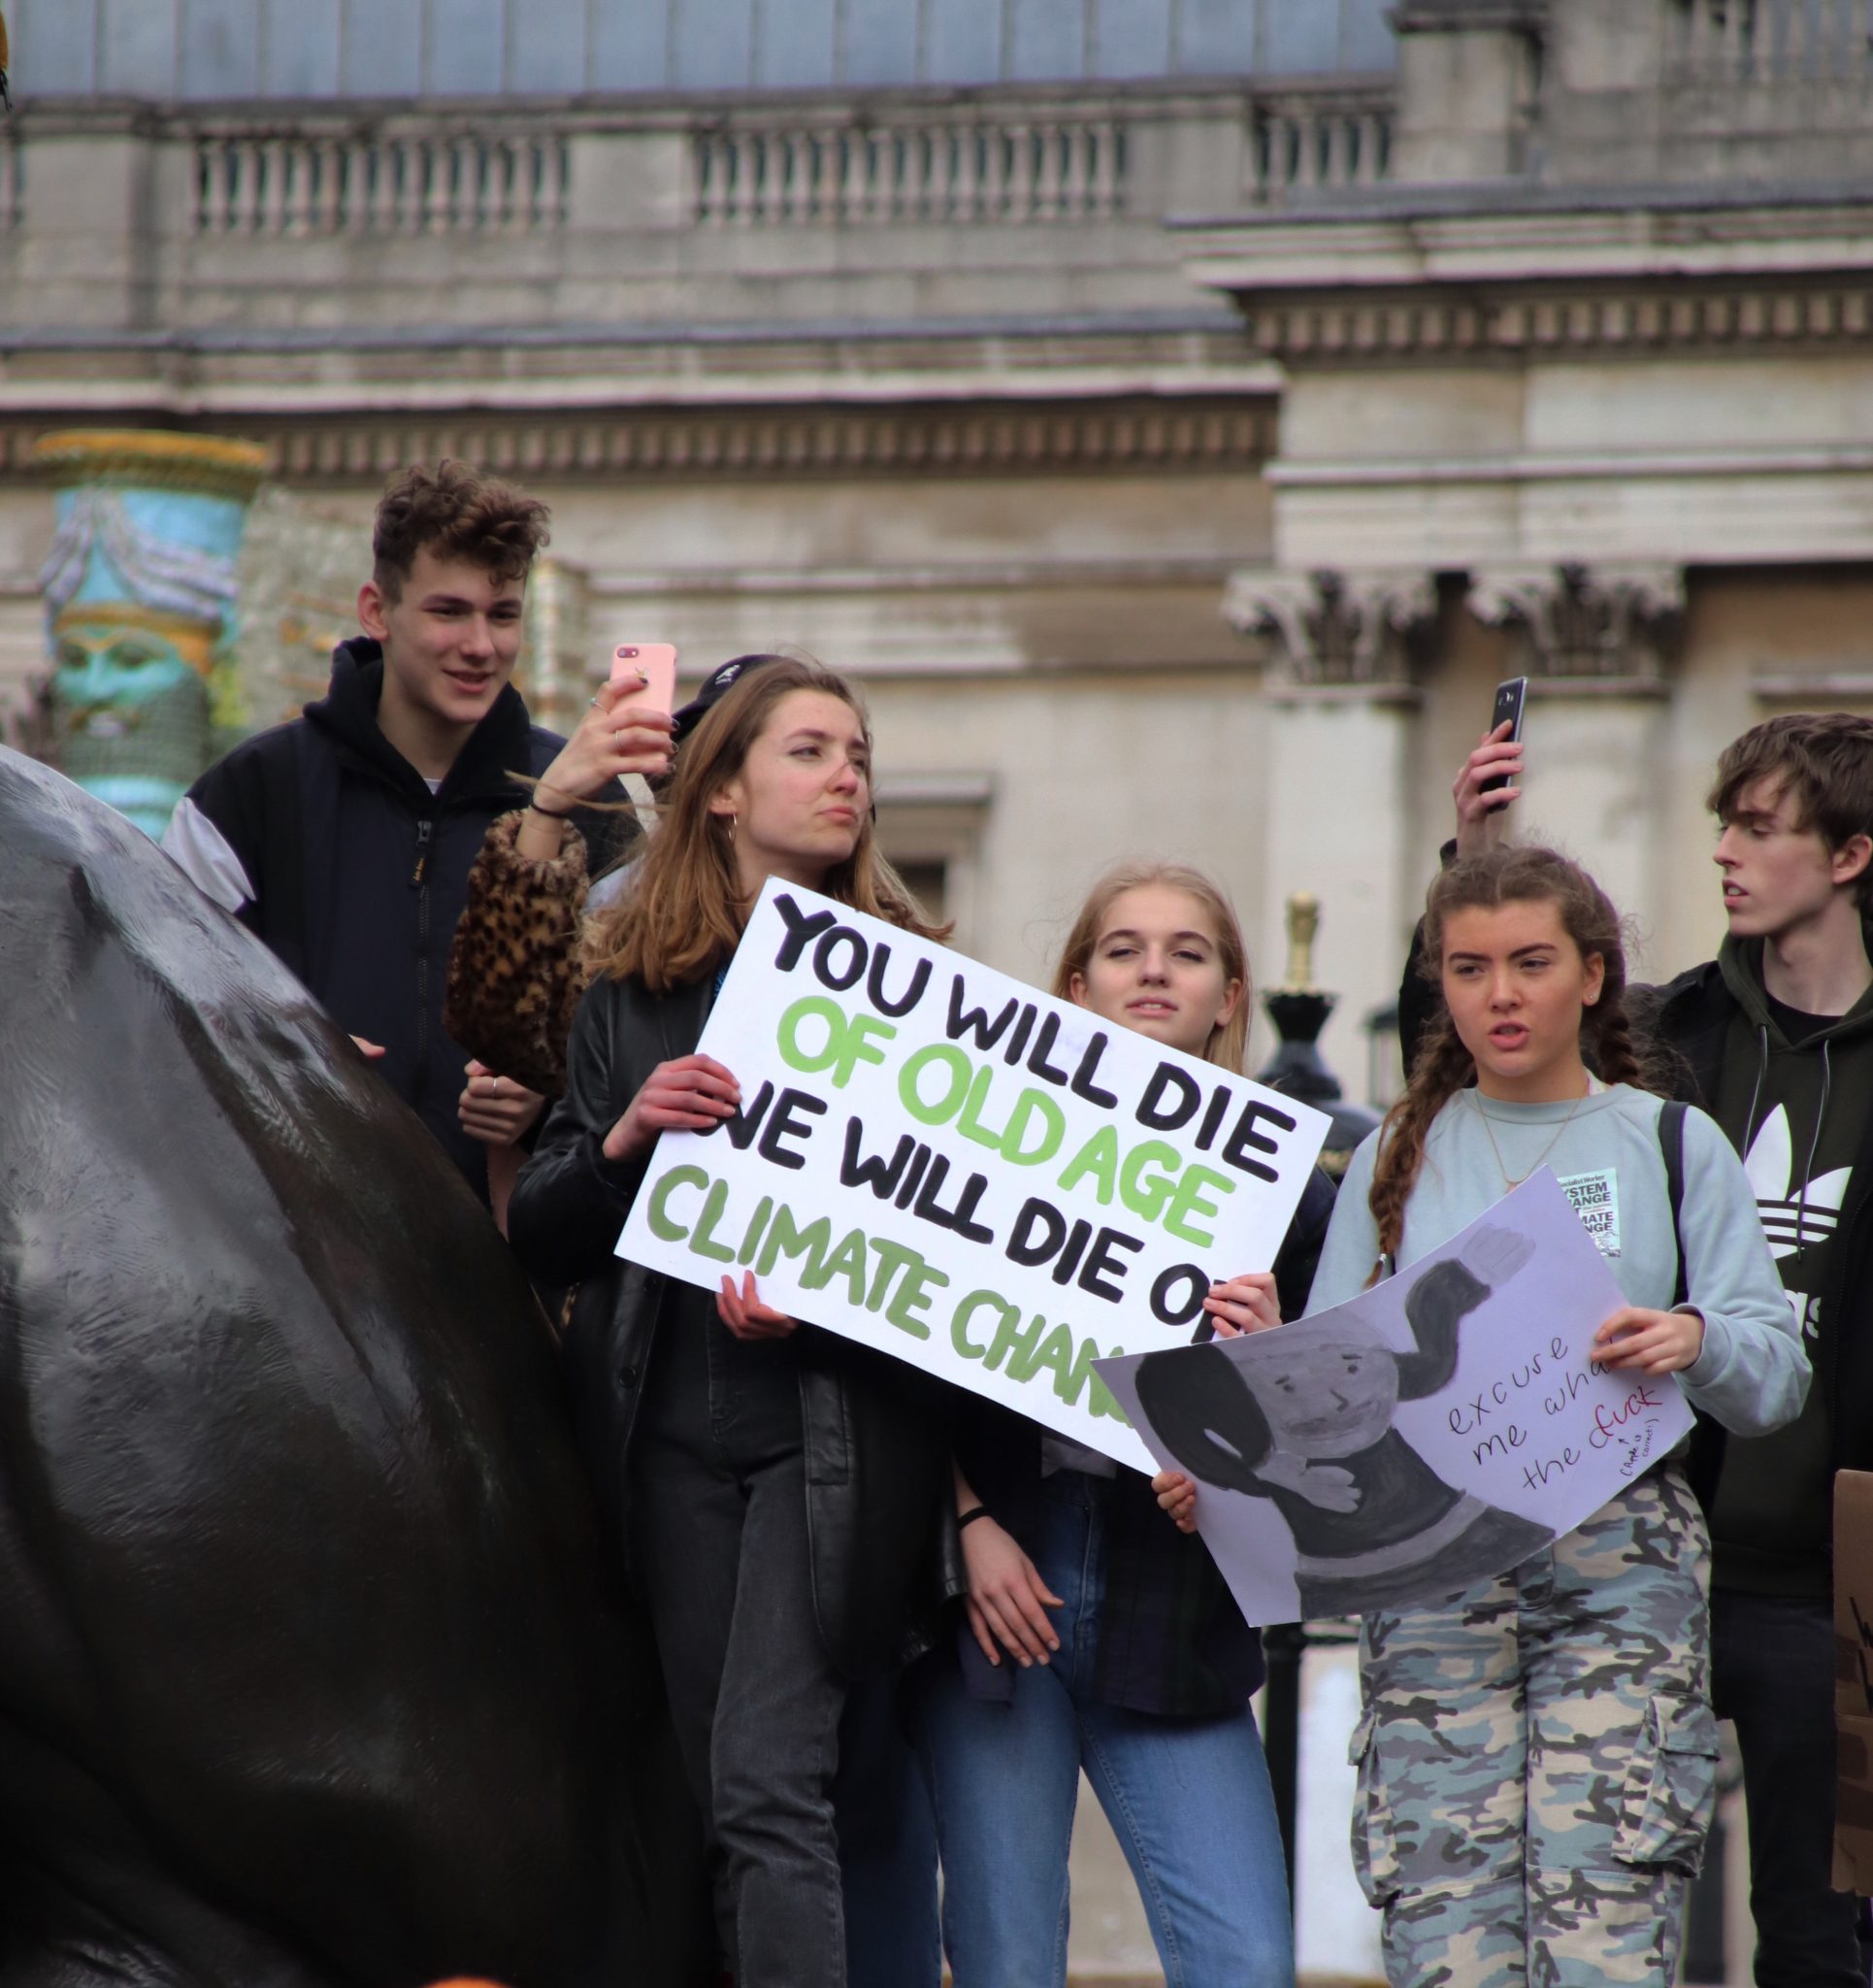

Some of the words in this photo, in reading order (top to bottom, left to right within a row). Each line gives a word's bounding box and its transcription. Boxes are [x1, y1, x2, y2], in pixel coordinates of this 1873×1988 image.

[774, 894, 933, 1018] YOU
[947, 974, 1118, 1109] WILL
[1135, 1061, 1297, 1183] DIE
[777, 996, 897, 1088] OF
[898, 1044, 1066, 1166] OLD
[1057, 1125, 1235, 1248] AGE
[1584, 1175, 1605, 1183] Worker
[839, 1116, 994, 1244] WILL
[1004, 1197, 1145, 1304] DIE
[1568, 1192, 1612, 1207] ANGE
[646, 1165, 949, 1341] CLIMATE
[950, 1289, 1134, 1428] CHAN
[1449, 1337, 1568, 1435] excuse
[1472, 1424, 1527, 1465] me
[1545, 1337, 1613, 1414] wha
[1522, 1447, 1581, 1490] the
